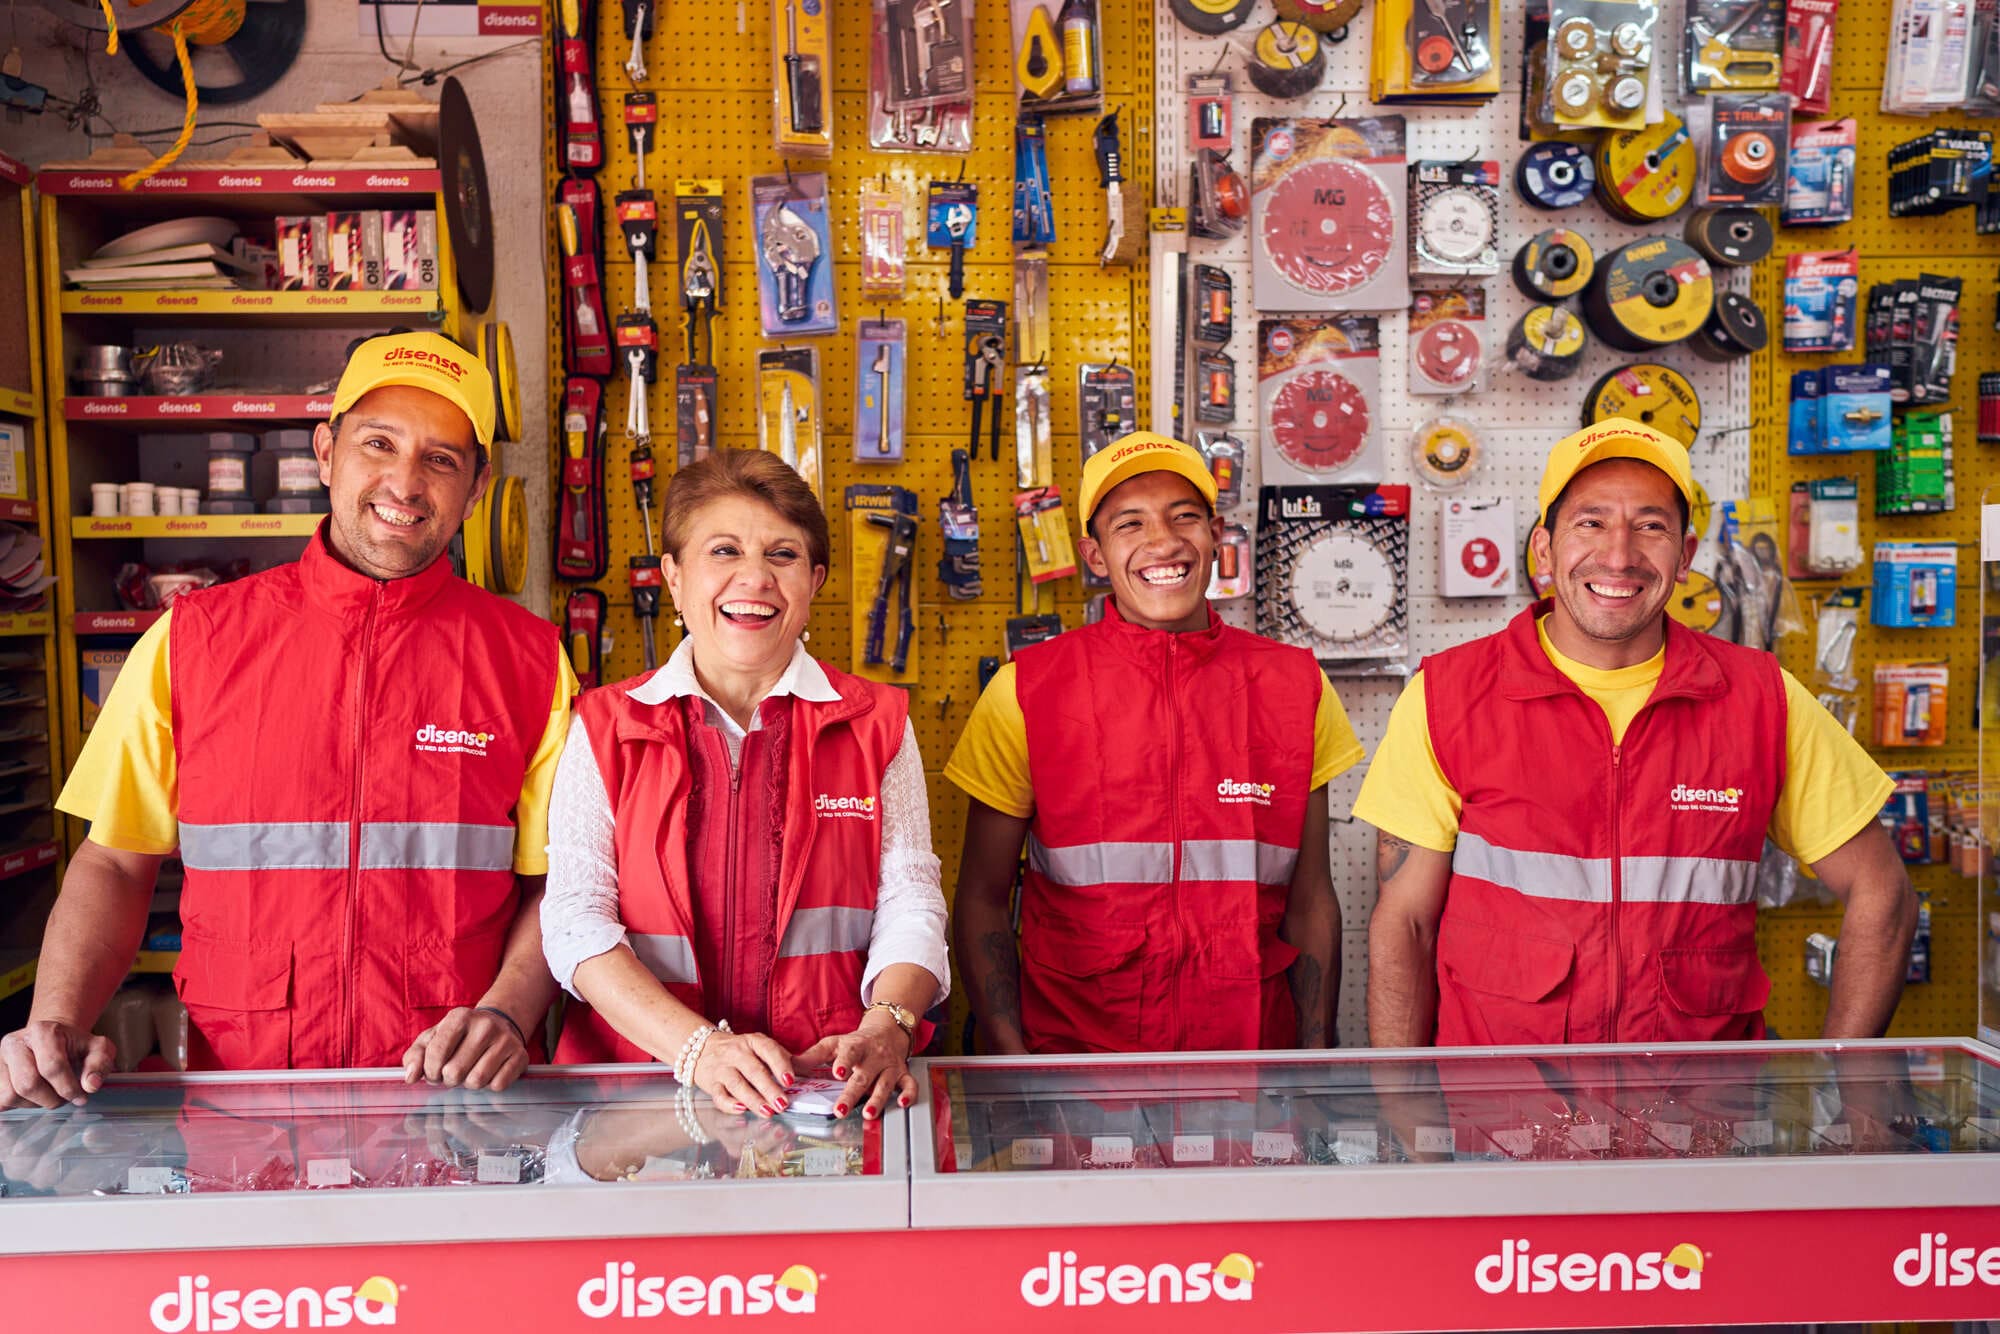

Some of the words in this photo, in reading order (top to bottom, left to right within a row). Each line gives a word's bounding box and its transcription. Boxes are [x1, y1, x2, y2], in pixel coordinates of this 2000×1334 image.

[484, 12, 537, 26] disensa
[69, 177, 113, 188] disensa
[144, 176, 187, 187] disensa
[218, 176, 262, 187] disensa
[292, 175, 336, 187] disensa
[366, 175, 409, 187] disensa
[1313, 188, 1345, 206] MG
[231, 295, 273, 305] disensa
[306, 295, 348, 305] disensa
[380, 295, 422, 305] disensa
[384, 347, 462, 376] disensa
[84, 402, 128, 413] disensa
[158, 402, 201, 412] disensa
[232, 401, 275, 412] disensa
[306, 400, 334, 412] dise
[855, 495, 891, 507] IRWIN
[92, 616, 136, 628] disensa
[416, 724, 487, 748] disensa
[1217, 778, 1272, 799] disensa
[1671, 784, 1739, 804] disensa
[1474, 1238, 1705, 1295] disensa
[1892, 1232, 2000, 1288] dise
[1019, 1250, 1256, 1307] disensa
[576, 1260, 819, 1318] disensa
[149, 1274, 399, 1333] disensa
